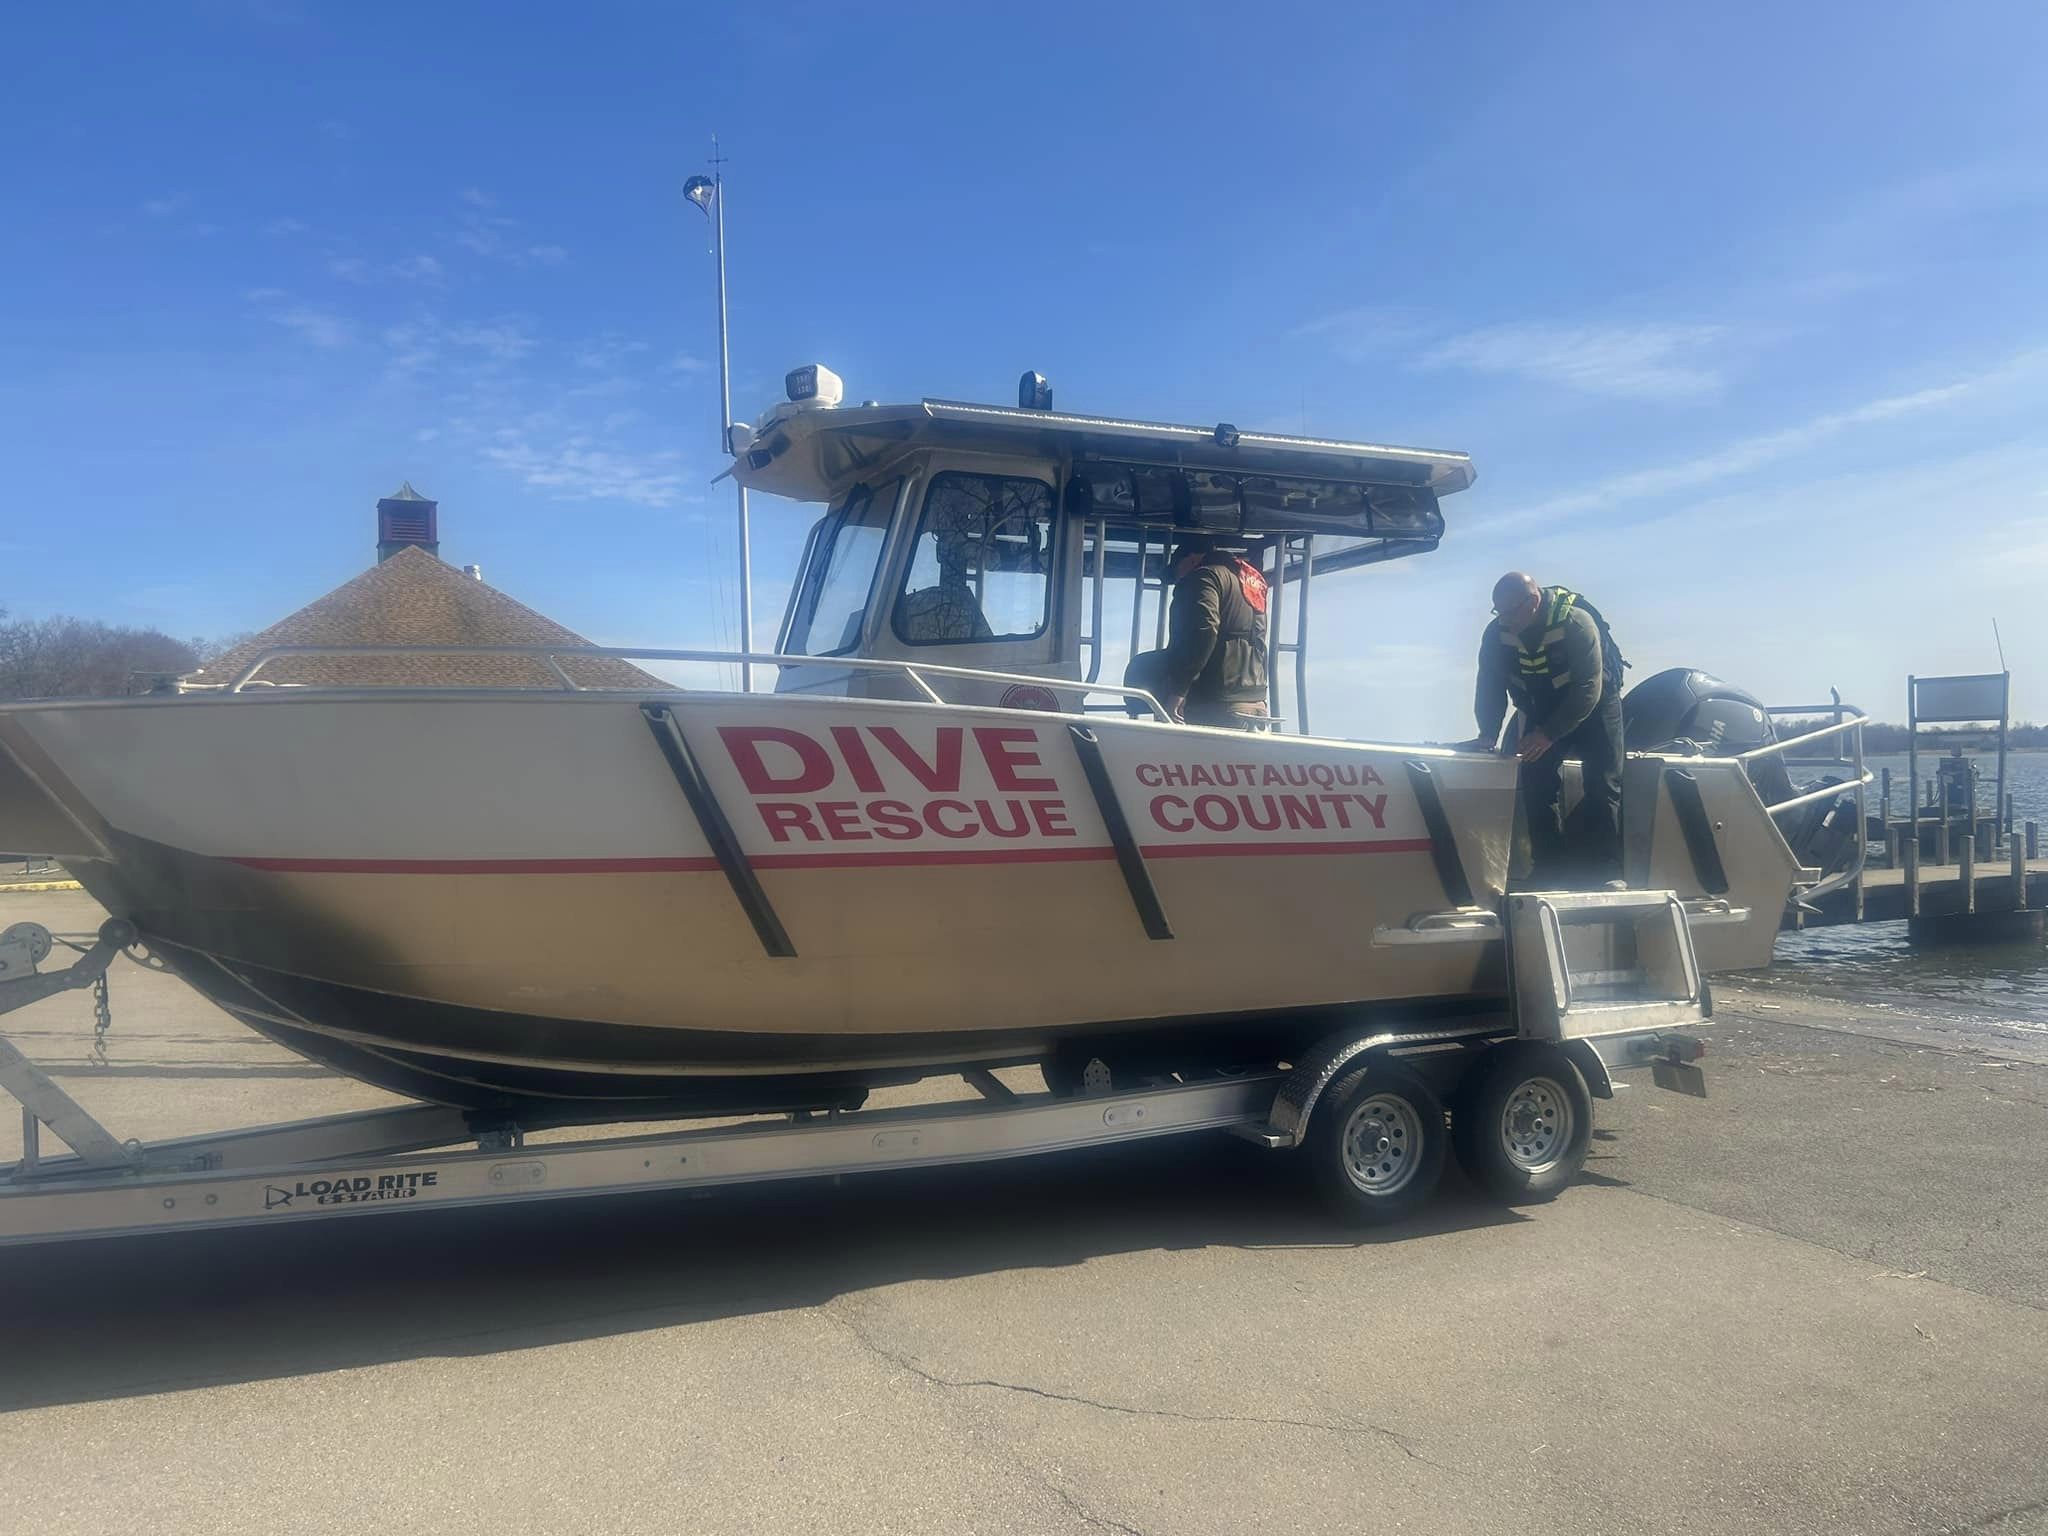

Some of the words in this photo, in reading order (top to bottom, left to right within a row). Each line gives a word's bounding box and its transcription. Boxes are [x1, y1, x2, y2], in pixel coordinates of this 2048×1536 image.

[717, 727, 1059, 794] DIVE
[1135, 763, 1385, 790] CHAUTAUQUA
[755, 800, 1077, 842] RESCUE
[1149, 794, 1388, 832] COUNTY
[295, 1177, 372, 1197] LOAD
[378, 1171, 438, 1189] RITE
